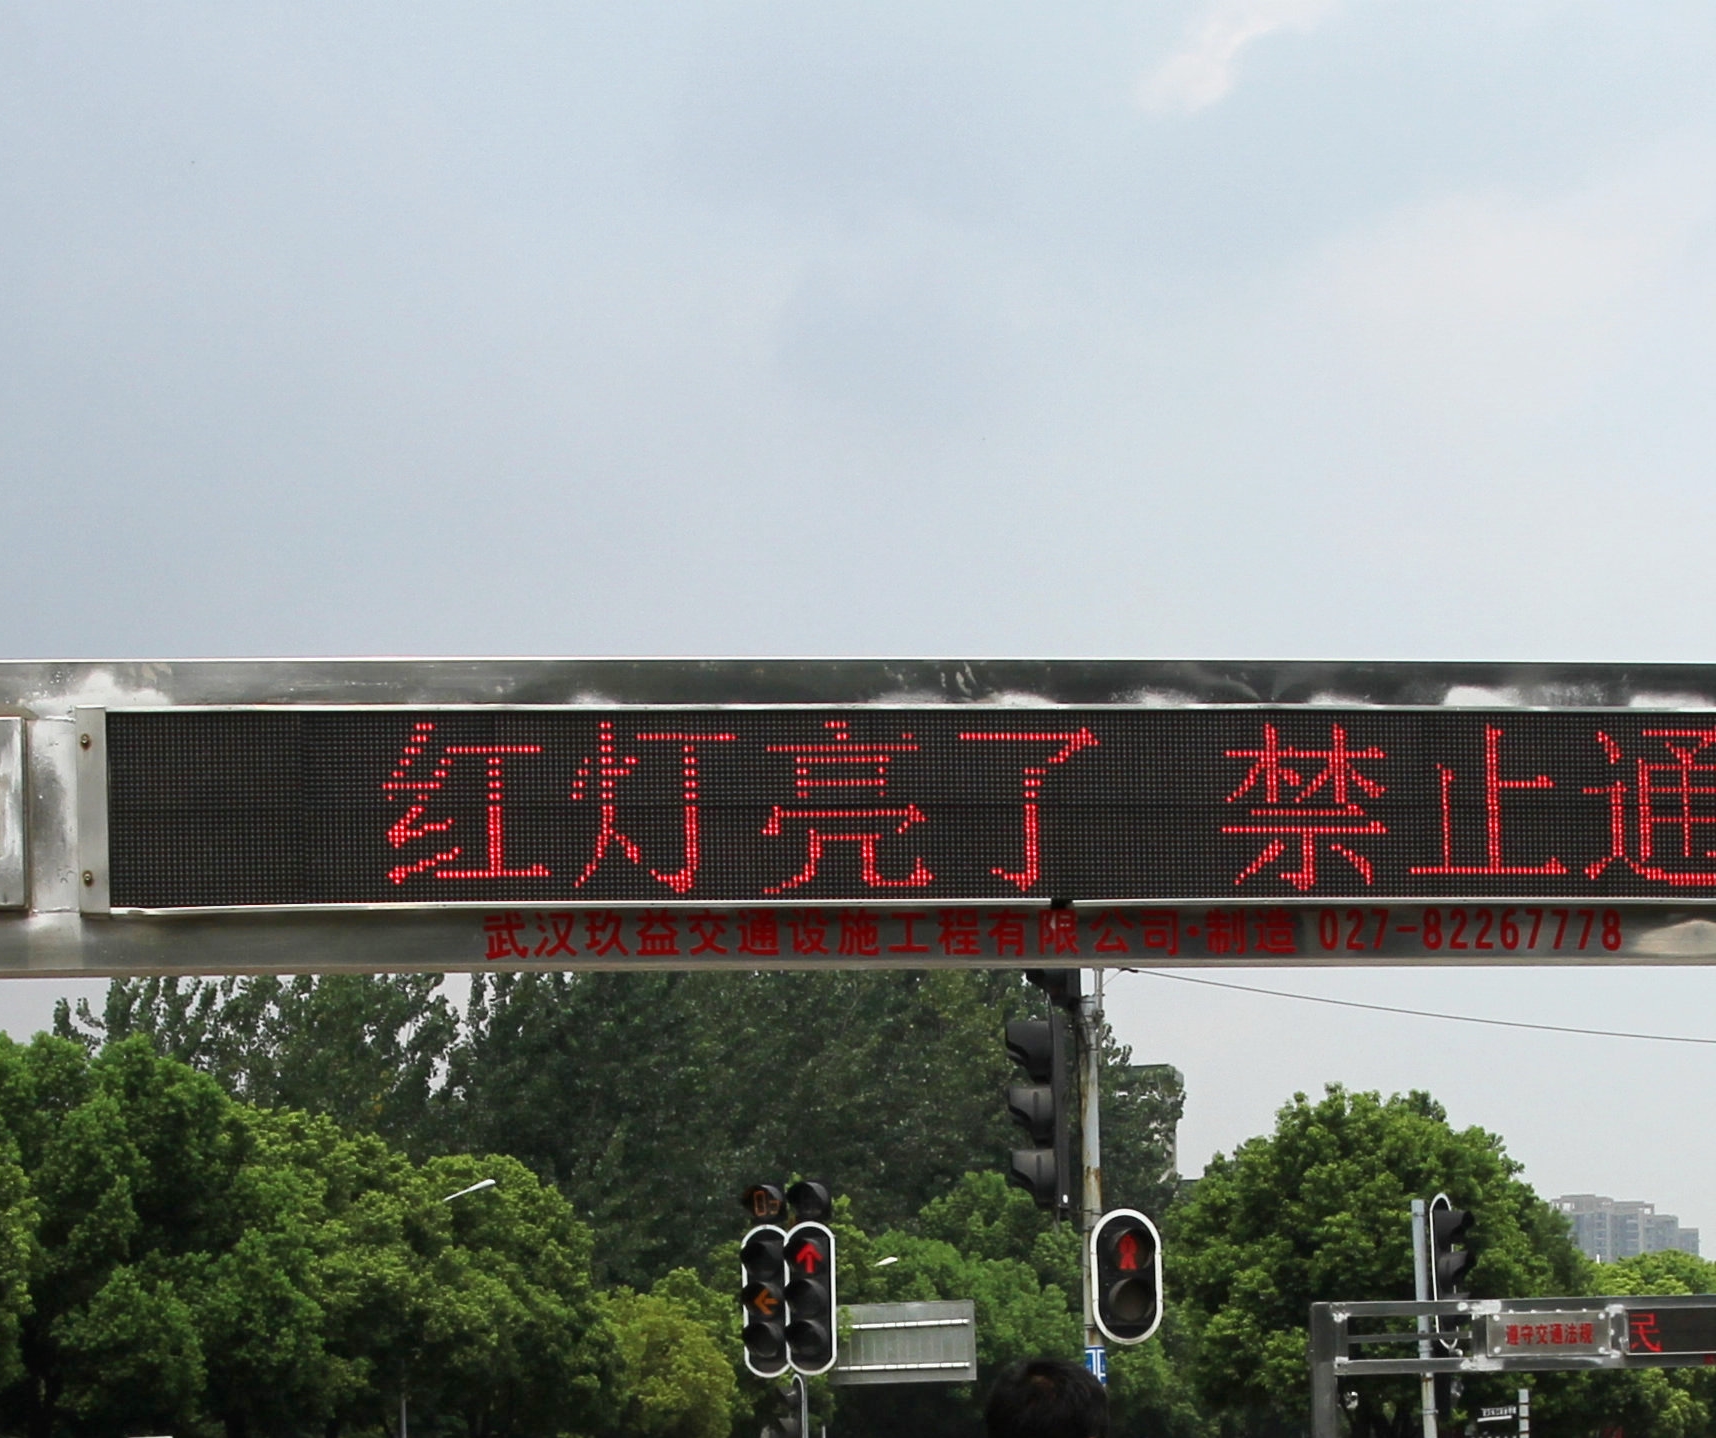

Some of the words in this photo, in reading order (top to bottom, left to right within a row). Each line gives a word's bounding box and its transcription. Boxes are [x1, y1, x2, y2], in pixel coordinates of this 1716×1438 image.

[382, 719, 1100, 895] 红灯亮了
[1318, 908, 1623, 953] 027-82267778
[1505, 1322, 1594, 1346] 遵守交通法规
